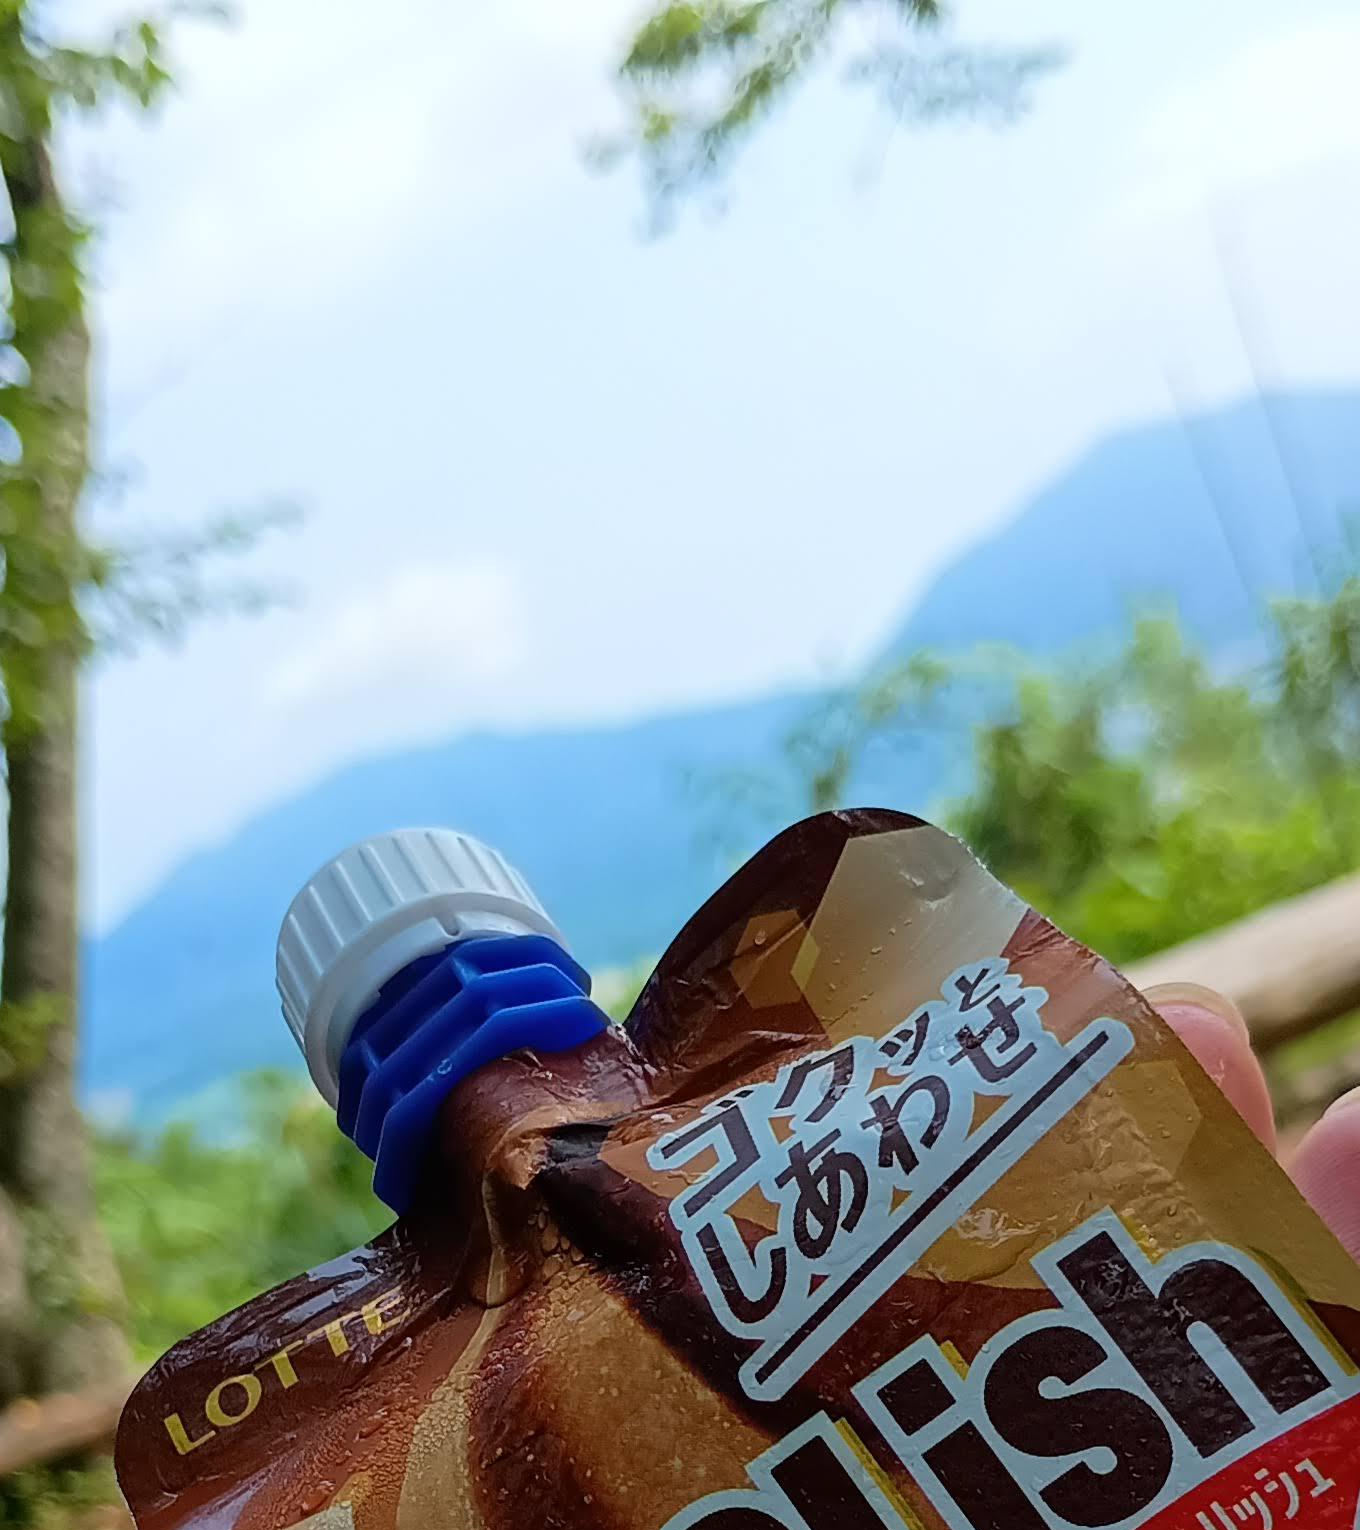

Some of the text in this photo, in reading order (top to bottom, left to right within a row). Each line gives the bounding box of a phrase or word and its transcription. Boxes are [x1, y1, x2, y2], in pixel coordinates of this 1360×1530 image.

[661, 967, 1001, 1216] ゴクッと
[694, 995, 1038, 1324] しあわせ
[163, 1286, 411, 1455] LOTTE
